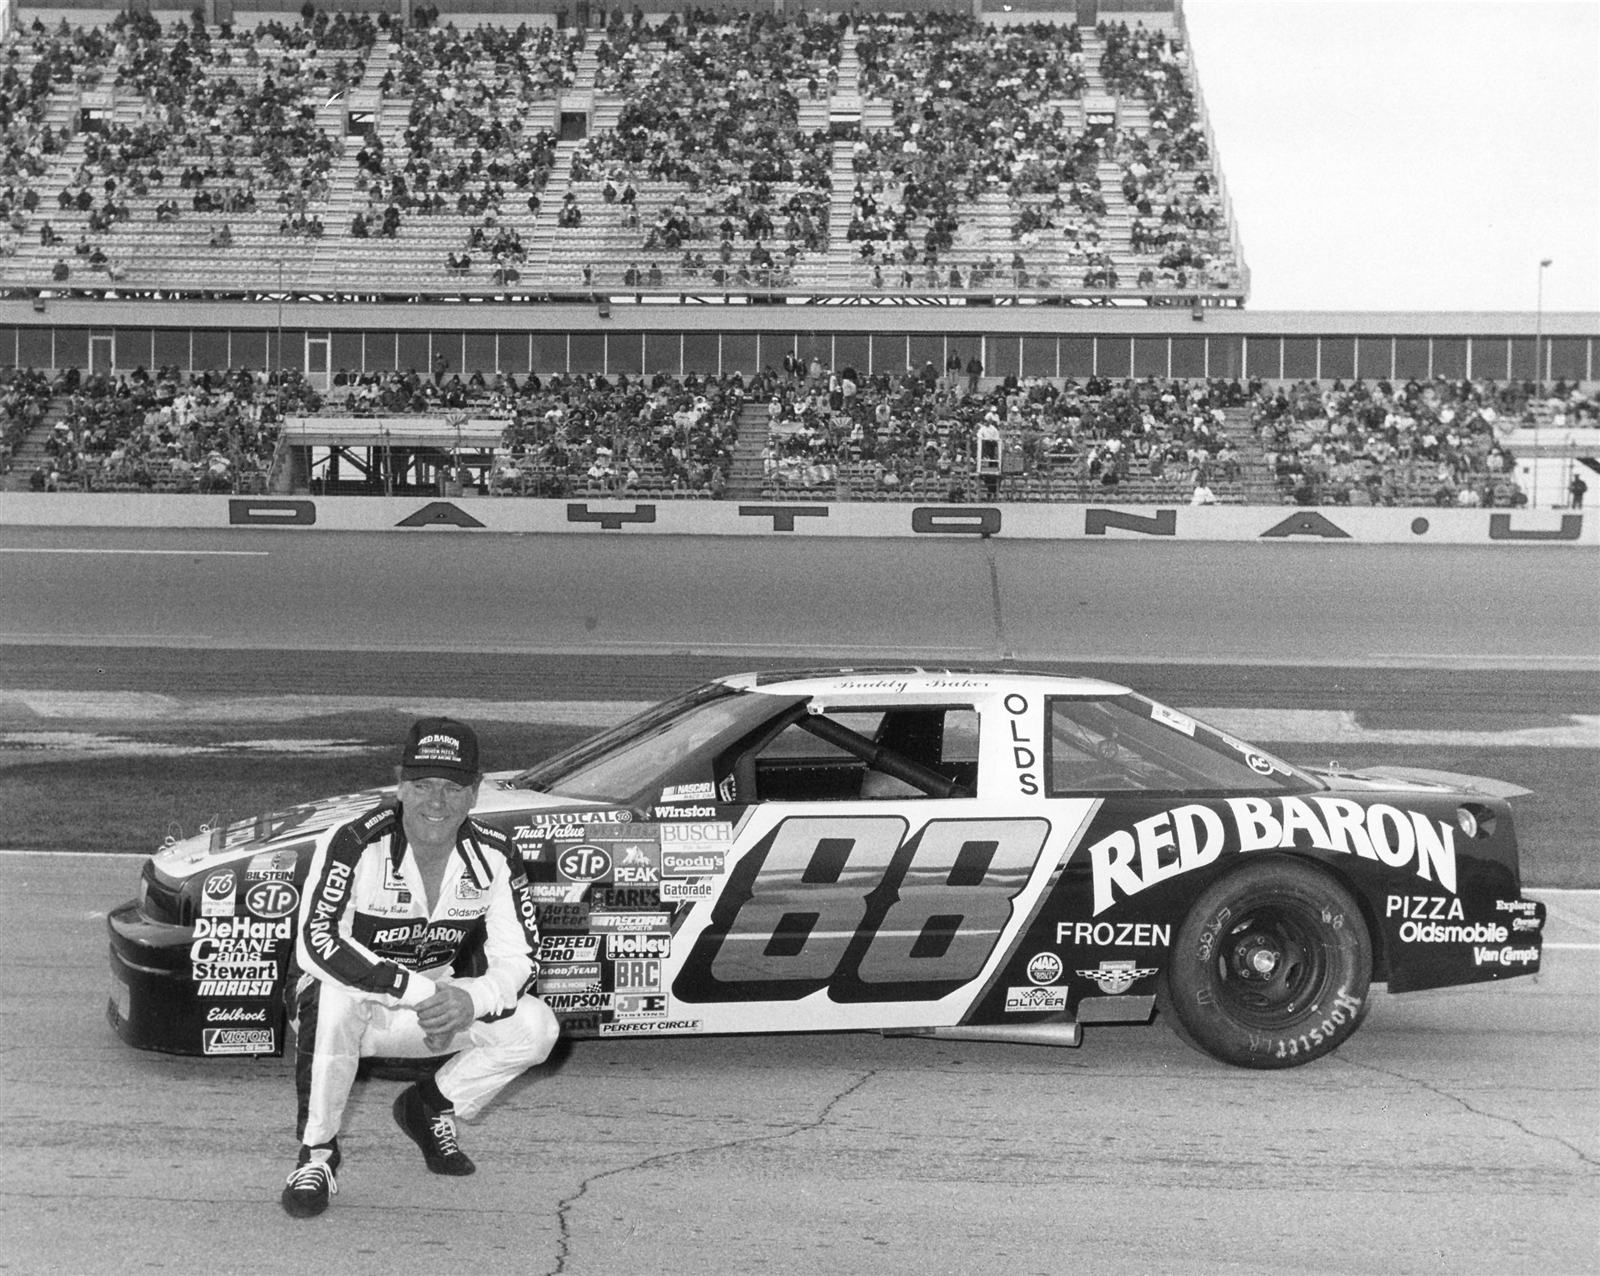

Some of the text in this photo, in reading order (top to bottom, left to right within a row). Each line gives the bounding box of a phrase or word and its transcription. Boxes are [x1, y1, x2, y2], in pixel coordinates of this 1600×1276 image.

[833, 680, 989, 693] Buddy Baker
[433, 734, 460, 750] BARON
[1003, 693, 1040, 797] OLDS
[679, 782, 711, 794] NASCAR
[532, 812, 617, 825] UNOCAL
[654, 804, 716, 818] Winston
[662, 824, 731, 842] BUSCH
[564, 849, 605, 875] STP
[664, 855, 724, 871] Goody's
[1088, 797, 1457, 917] RED BARON
[246, 871, 294, 881] BILSTEIN
[614, 867, 659, 882] PEAK
[207, 874, 234, 894] 76
[664, 884, 712, 896] Gatorade
[252, 884, 292, 911] STP
[310, 860, 352, 961] RED BARON
[690, 815, 1053, 1003] 88
[1386, 896, 1465, 921] PIZZA
[192, 917, 292, 939] DieHard
[373, 927, 410, 944] RED
[1056, 922, 1171, 947] FROZEN
[1399, 921, 1509, 943] Oldsmobile
[541, 936, 597, 949] SPEED
[608, 934, 670, 958] Holley
[541, 948, 575, 961] PRO
[1473, 946, 1499, 966] Van
[195, 962, 276, 979] Stewart
[540, 965, 598, 977] GOODYEAR
[1031, 956, 1059, 970] MAC
[197, 980, 274, 996] MOROSO
[543, 993, 611, 1008] SIMPSON
[617, 995, 666, 1012] JE
[1007, 997, 1064, 1007] OLIVER
[206, 1007, 267, 1021] Edelbrock
[1275, 984, 1362, 1059] Hoosier
[603, 1020, 700, 1032] PERFECT CIRCLE
[220, 1030, 270, 1043] VICTOR
